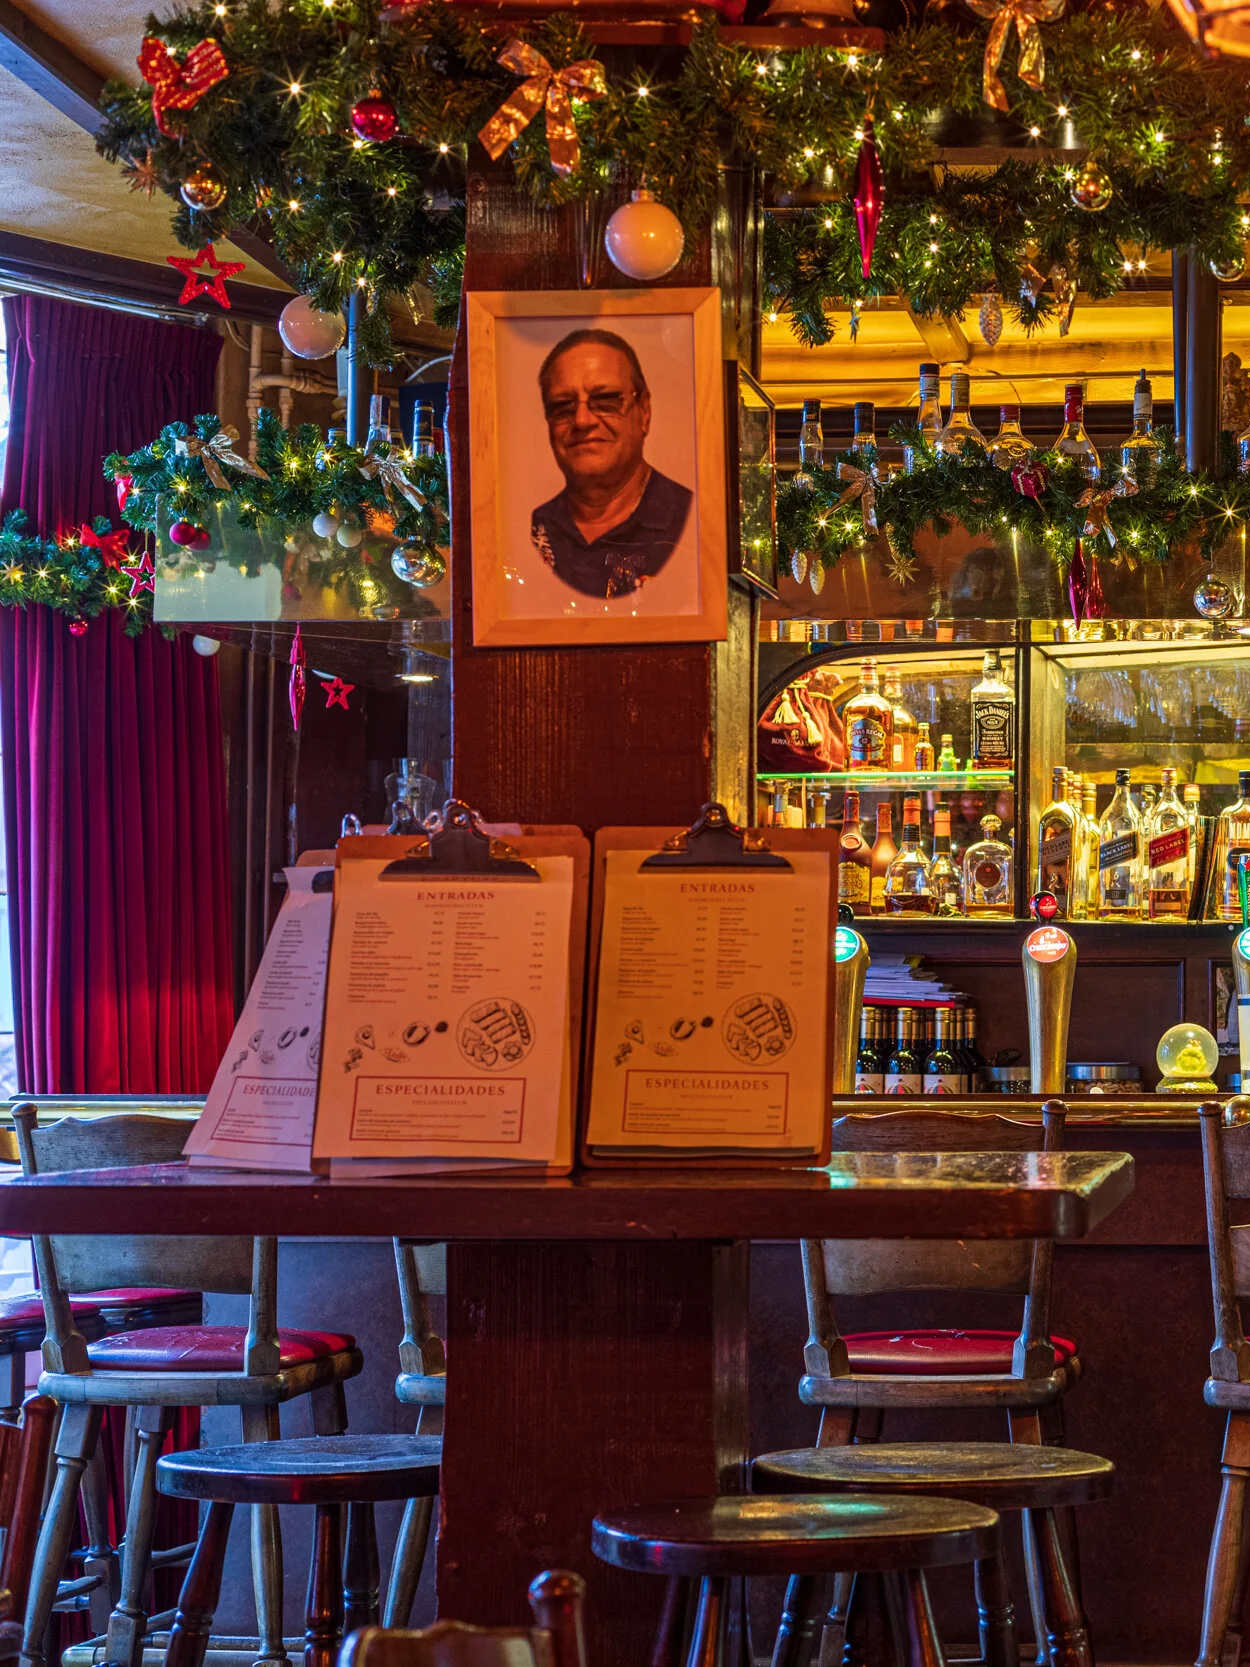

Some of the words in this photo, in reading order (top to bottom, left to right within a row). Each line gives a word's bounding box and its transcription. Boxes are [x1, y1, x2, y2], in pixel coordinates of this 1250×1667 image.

[976, 708, 989, 719] JACK
[1150, 845, 1165, 855] RED
[1165, 838, 1185, 850] LABEL
[679, 883, 756, 893] ENTRADAS
[416, 891, 496, 901] ENTRADAS
[644, 1077, 770, 1090] ESPECIALIDADES
[242, 1083, 316, 1097] ESPECIALIDADE
[375, 1084, 506, 1096] ESPECIALIDADES
